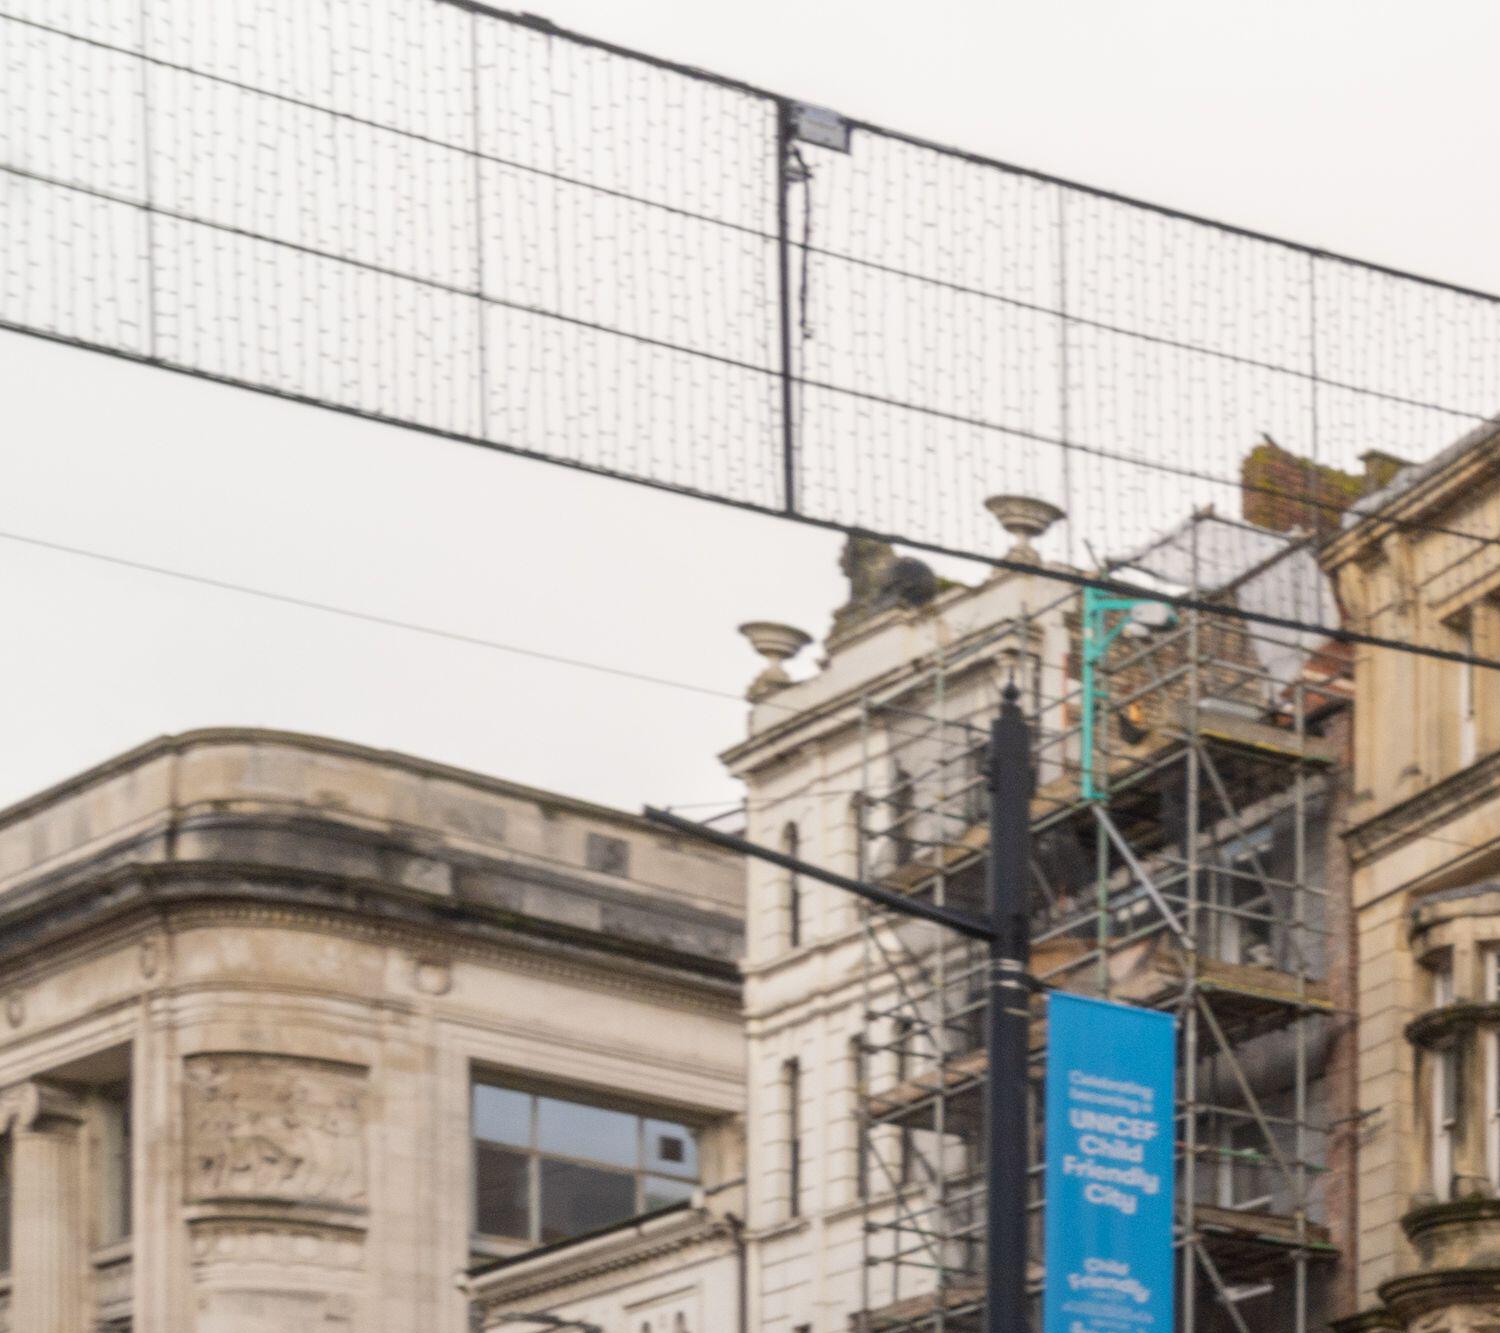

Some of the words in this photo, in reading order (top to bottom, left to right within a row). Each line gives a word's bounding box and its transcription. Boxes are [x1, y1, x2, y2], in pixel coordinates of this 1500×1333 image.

[1069, 1108, 1158, 1141] UNICEF
[1079, 1134, 1144, 1164] Child
[1063, 1155, 1159, 1194] Friendly
[1084, 1183, 1138, 1216] City
